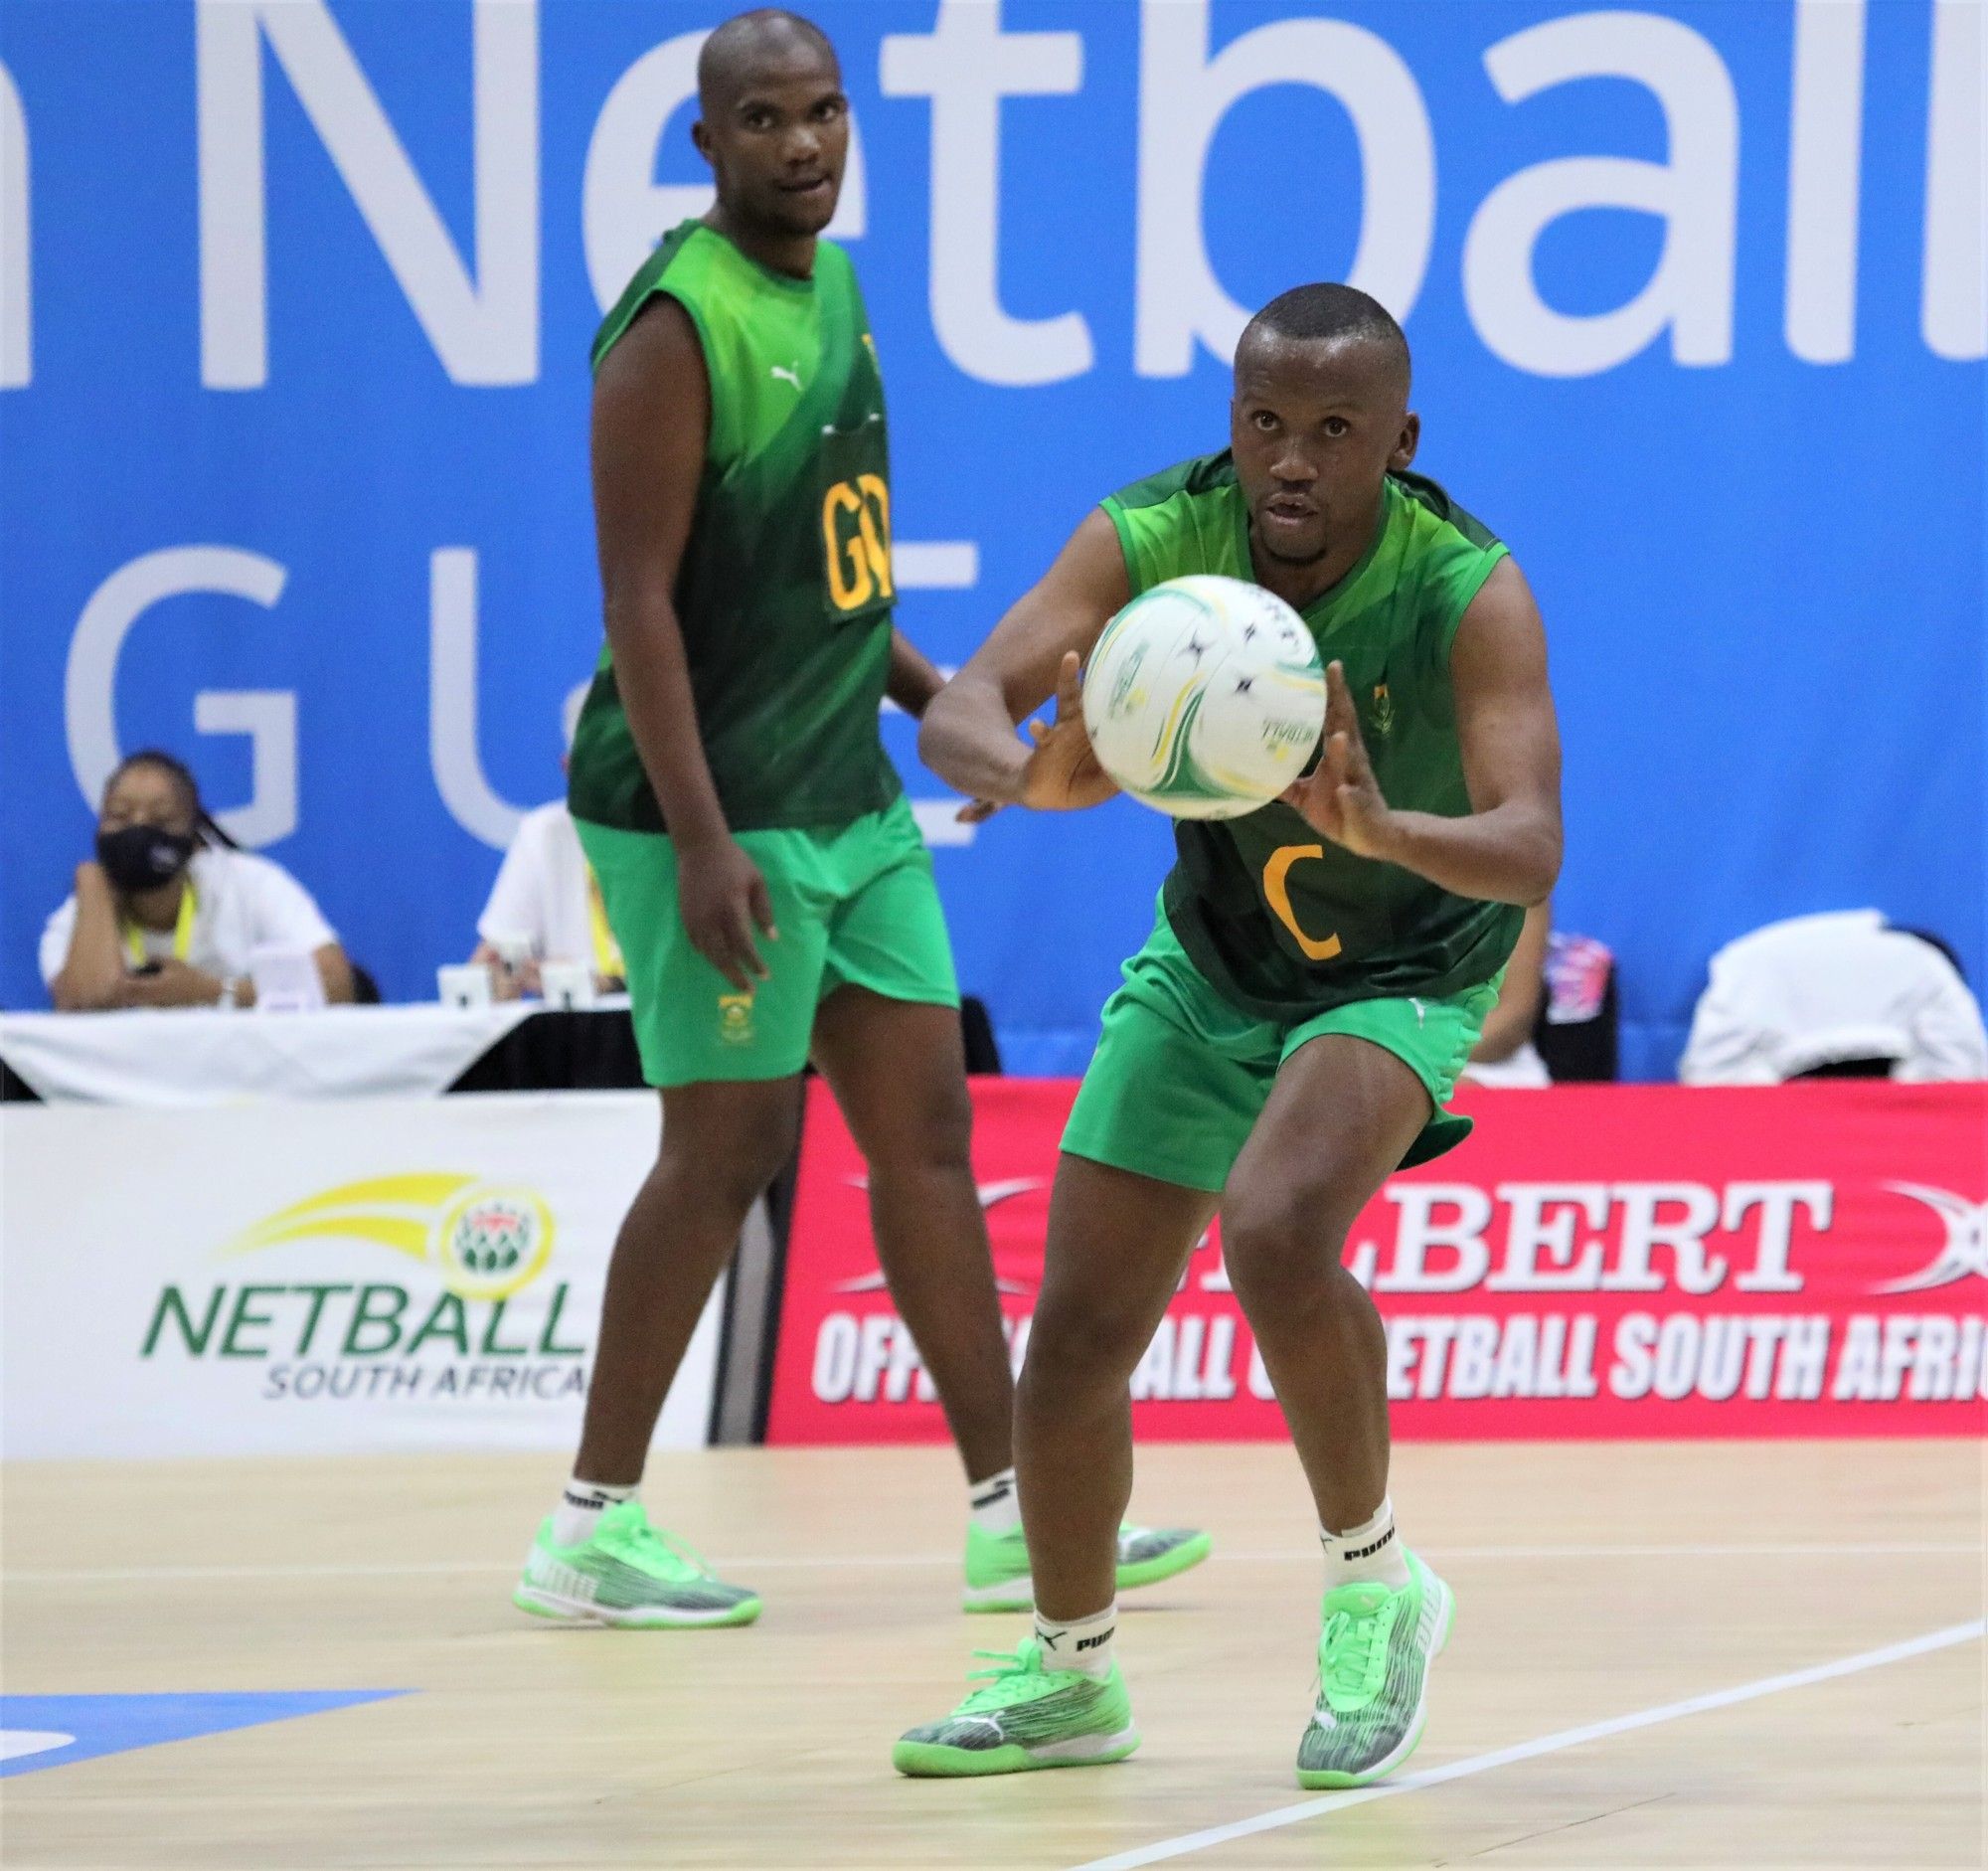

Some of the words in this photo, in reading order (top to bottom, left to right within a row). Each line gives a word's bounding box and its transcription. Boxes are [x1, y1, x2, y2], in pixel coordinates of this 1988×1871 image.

[196, 0, 1988, 389] Netball
[1262, 844, 1342, 960] C
[1177, 1179, 1833, 1292] BERT
[138, 1281, 586, 1359] NETBALL
[1128, 1313, 1236, 1401] ALL
[1383, 1311, 1598, 1400] ETBALL
[1608, 1310, 1830, 1401] SOUTH
[1831, 1312, 1988, 1402] AFRI
[263, 1364, 422, 1401] SOUTH
[437, 1364, 588, 1401] AFRICA
[1343, 1524, 1396, 1562] PUM
